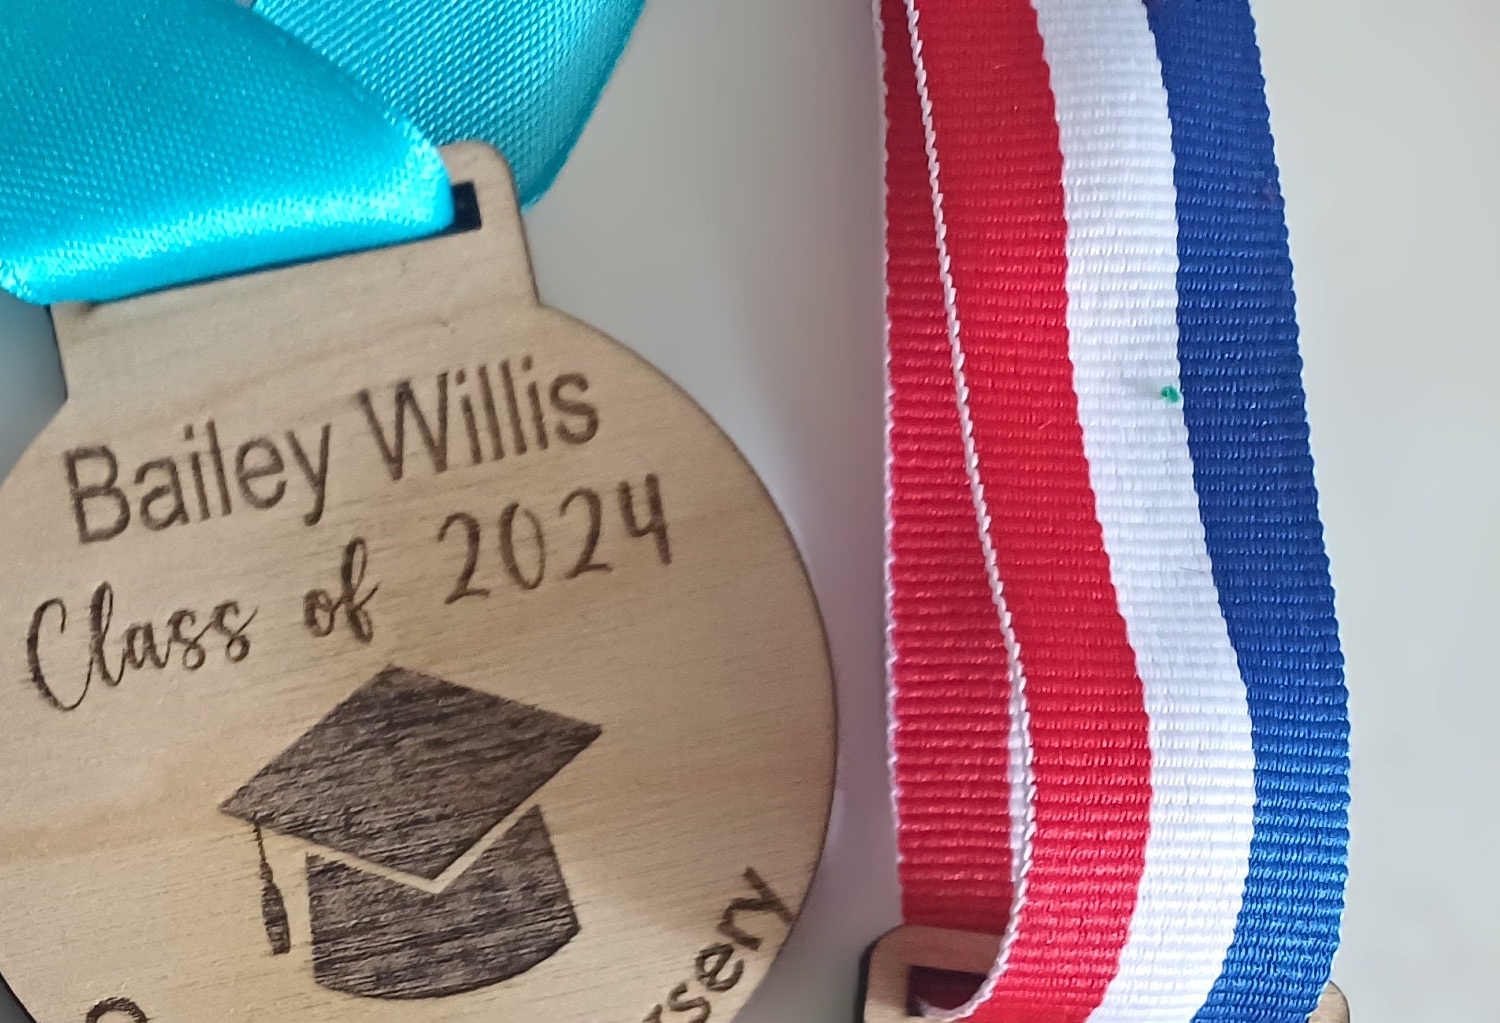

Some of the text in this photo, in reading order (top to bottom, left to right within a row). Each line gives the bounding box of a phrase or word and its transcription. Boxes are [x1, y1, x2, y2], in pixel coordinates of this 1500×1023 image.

[63, 355, 601, 545] Bailey Willis
[25, 472, 673, 712] Class of 2024
